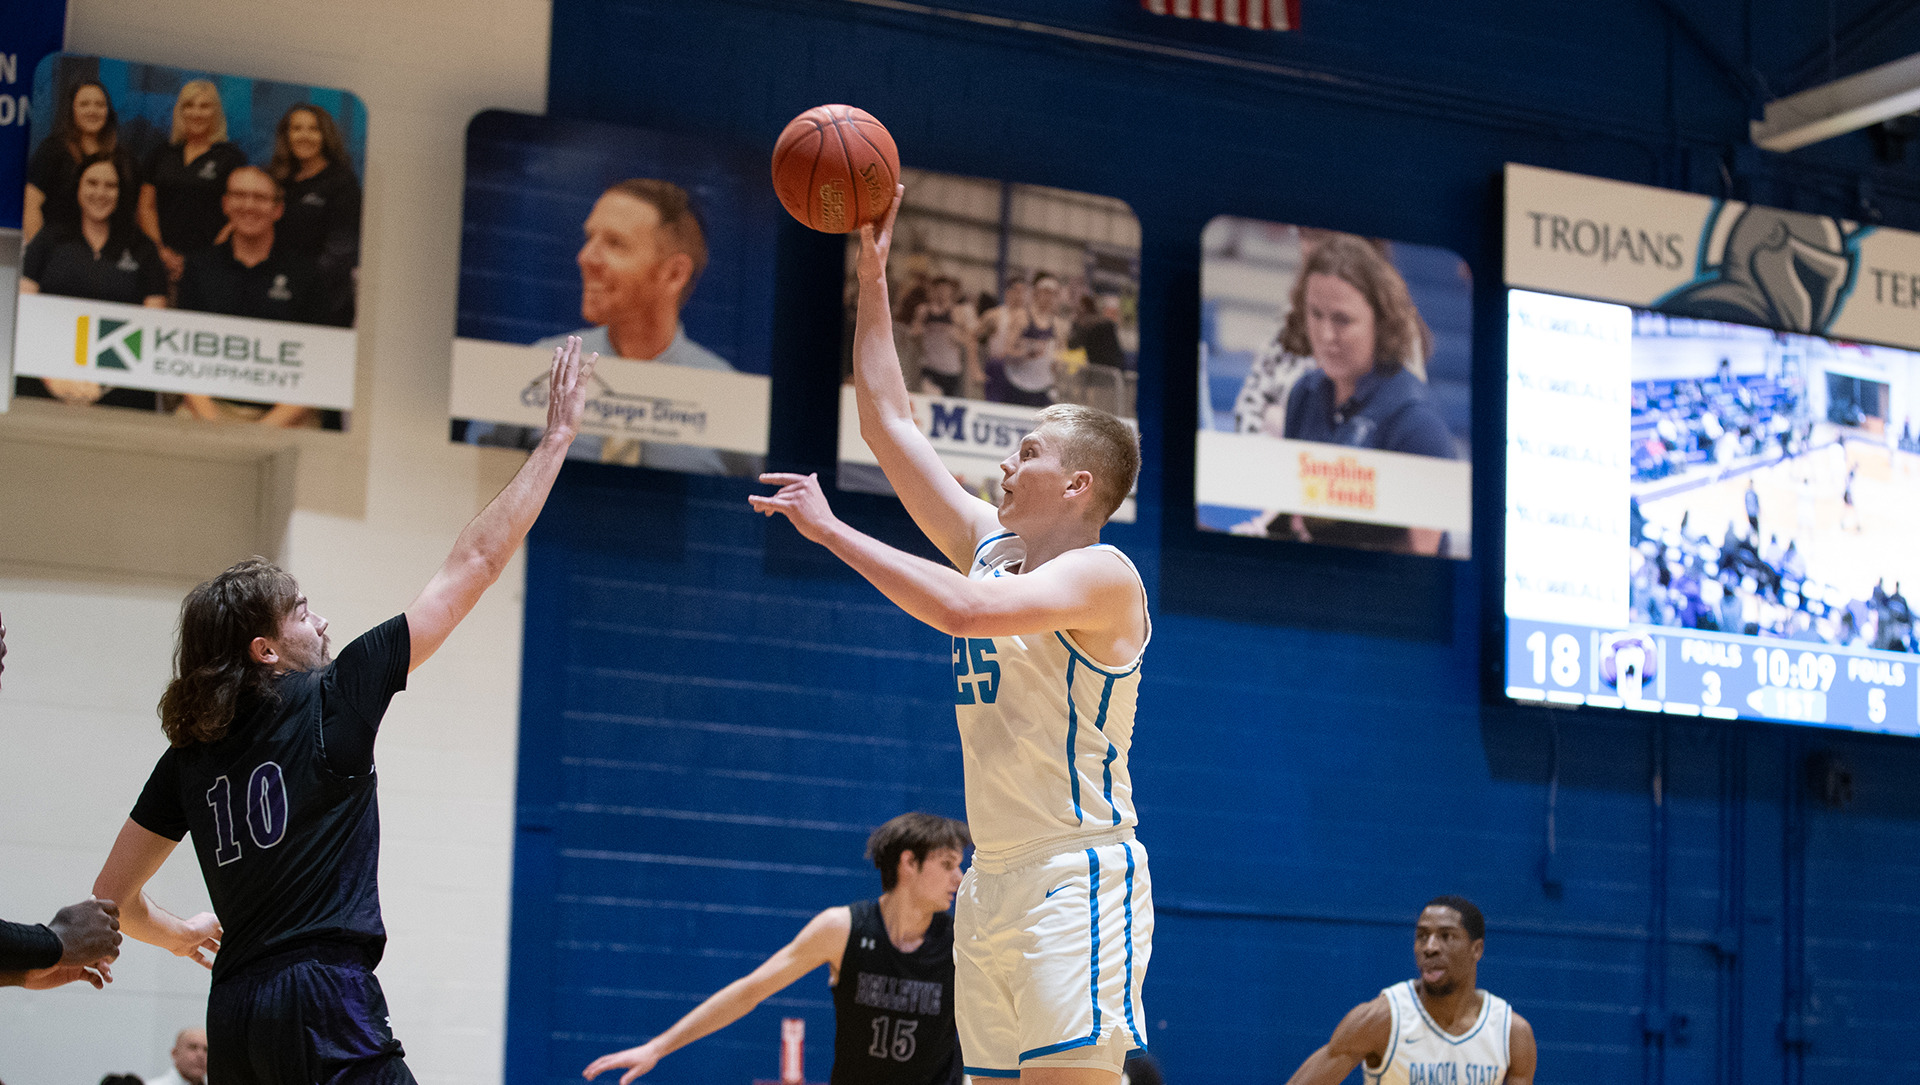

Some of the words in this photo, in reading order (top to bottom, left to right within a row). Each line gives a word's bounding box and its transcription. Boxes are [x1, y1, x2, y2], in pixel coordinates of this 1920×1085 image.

[1526, 211, 1685, 271] TROJANS
[153, 356, 303, 388] EQUIPMENT
[154, 326, 304, 367] KIBBLE
[953, 635, 1001, 705] 25
[1526, 631, 1581, 687] 18
[1681, 638, 1743, 669] FOULS
[1753, 647, 1837, 692] 10:09
[1848, 657, 1906, 687] FOULS
[1702, 670, 1722, 706] 3
[1867, 688, 1887, 723] 5
[206, 761, 288, 868] 10
[868, 1015, 919, 1062] 15
[1409, 1061, 1459, 1085] DAKOTA
